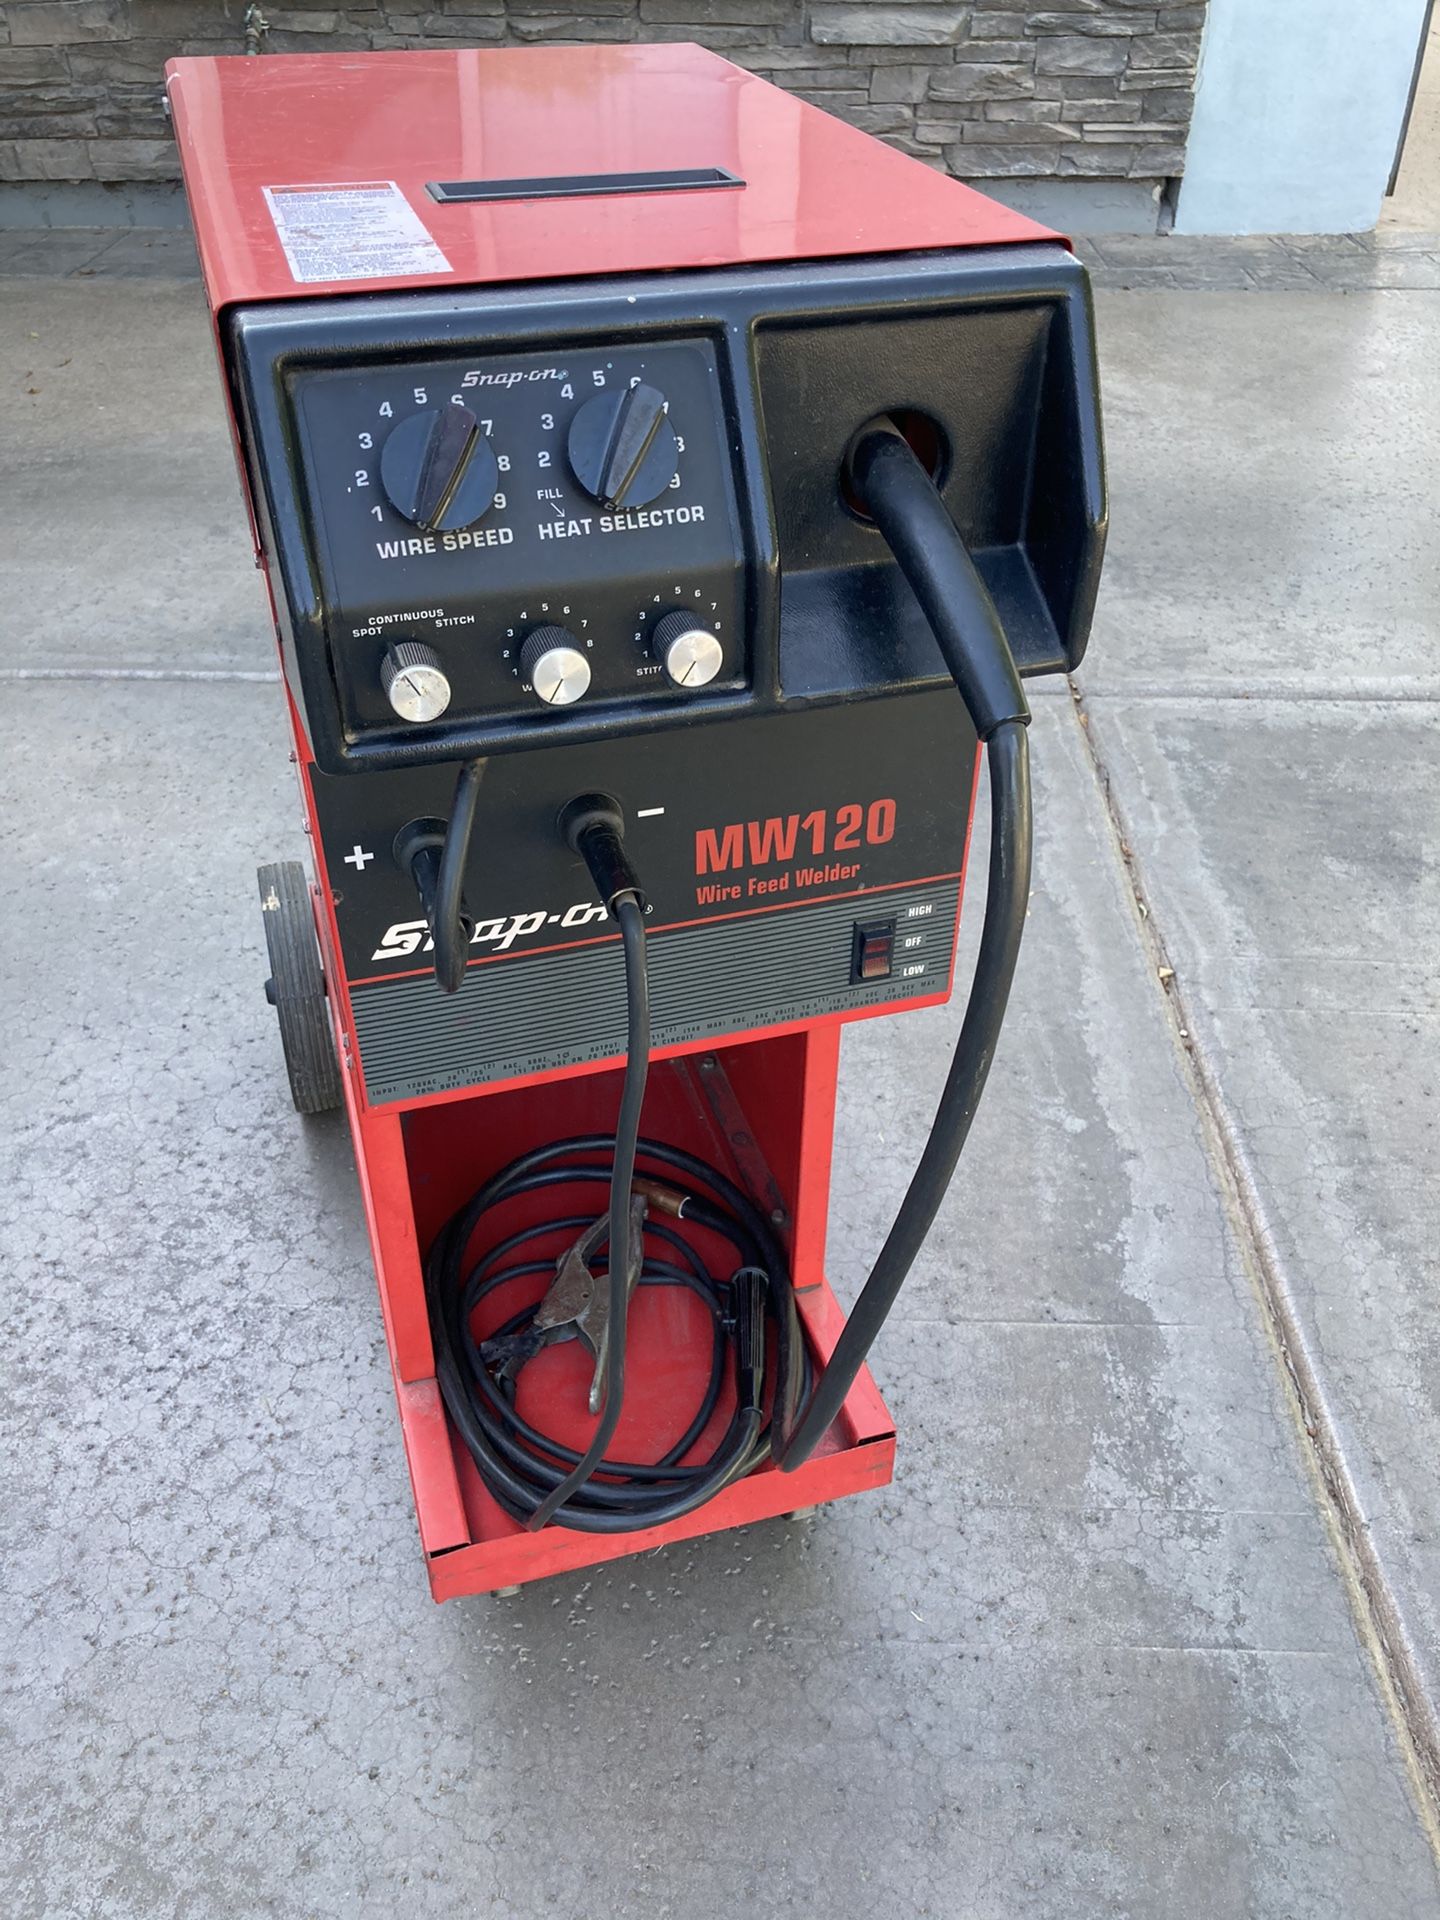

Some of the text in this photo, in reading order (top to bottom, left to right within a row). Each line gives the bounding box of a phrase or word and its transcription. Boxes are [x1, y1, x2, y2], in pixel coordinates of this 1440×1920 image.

[592, 370, 605, 386] 5
[414, 388, 428, 404] 5
[561, 384, 574, 399] 4
[379, 402, 393, 418] 4
[481, 420, 493, 435] 7
[541, 414, 554, 429] 3
[358, 433, 373, 449] 3
[497, 456, 510, 471] 8
[538, 452, 551, 467] 2
[355, 470, 369, 487] 2
[494, 493, 506, 509] 9
[537, 488, 563, 500] FILL
[371, 506, 383, 522] 1
[538, 505, 705, 540] HEAT SELECTOR
[377, 528, 514, 559] WIRE SPEED
[368, 608, 444, 626] CONTINUOUS
[435, 615, 475, 628] STITCH
[635, 633, 641, 641] 2
[639, 612, 646, 620] 3
[653, 595, 660, 603] 4
[675, 586, 681, 594] 5
[694, 589, 701, 597] 6
[711, 602, 717, 611] 7
[715, 622, 721, 630] 8
[352, 627, 382, 638] SPOT
[503, 650, 510, 658] 2
[507, 629, 514, 637] 3
[542, 603, 548, 611] 5
[563, 606, 570, 614] 6
[582, 620, 588, 628] 7
[695, 798, 897, 875] MW120
[696, 863, 861, 906] Wire Feed Welder
[908, 904, 932, 917] HIGH
[905, 936, 922, 947] OFF
[903, 964, 925, 976] LOW
